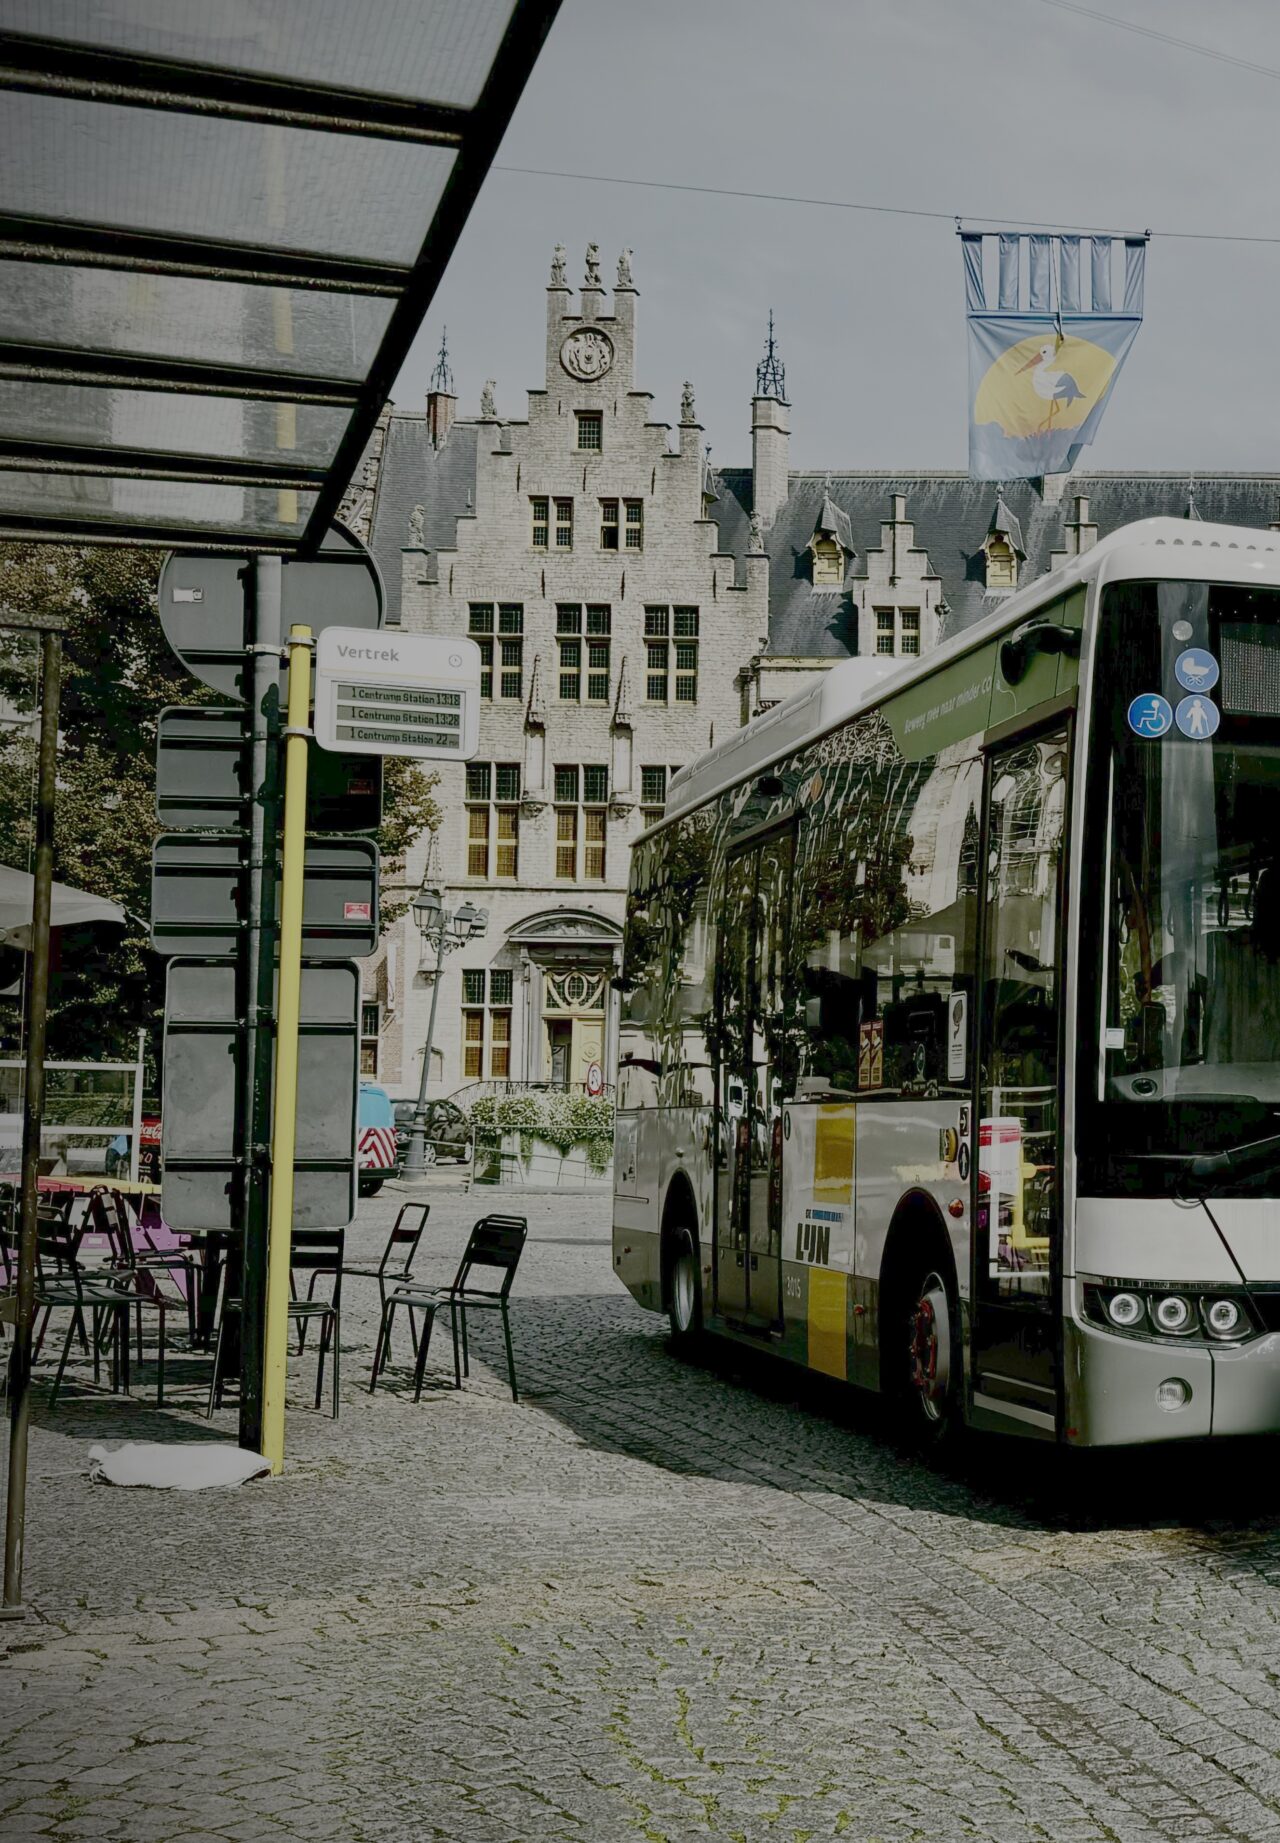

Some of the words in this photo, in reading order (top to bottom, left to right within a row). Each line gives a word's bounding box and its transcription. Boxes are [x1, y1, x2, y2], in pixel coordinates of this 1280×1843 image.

[336, 644, 400, 662] Vertrek
[352, 687, 357, 698] 1
[402, 692, 435, 705] Station
[436, 693, 461, 706] 13:18
[352, 706, 356, 718] 1
[402, 712, 434, 725] Station
[435, 712, 460, 727] 13:28
[351, 727, 356, 739] 1
[401, 732, 434, 744] Station
[436, 733, 448, 745] 22
[796, 1223, 830, 1266] LIJN
